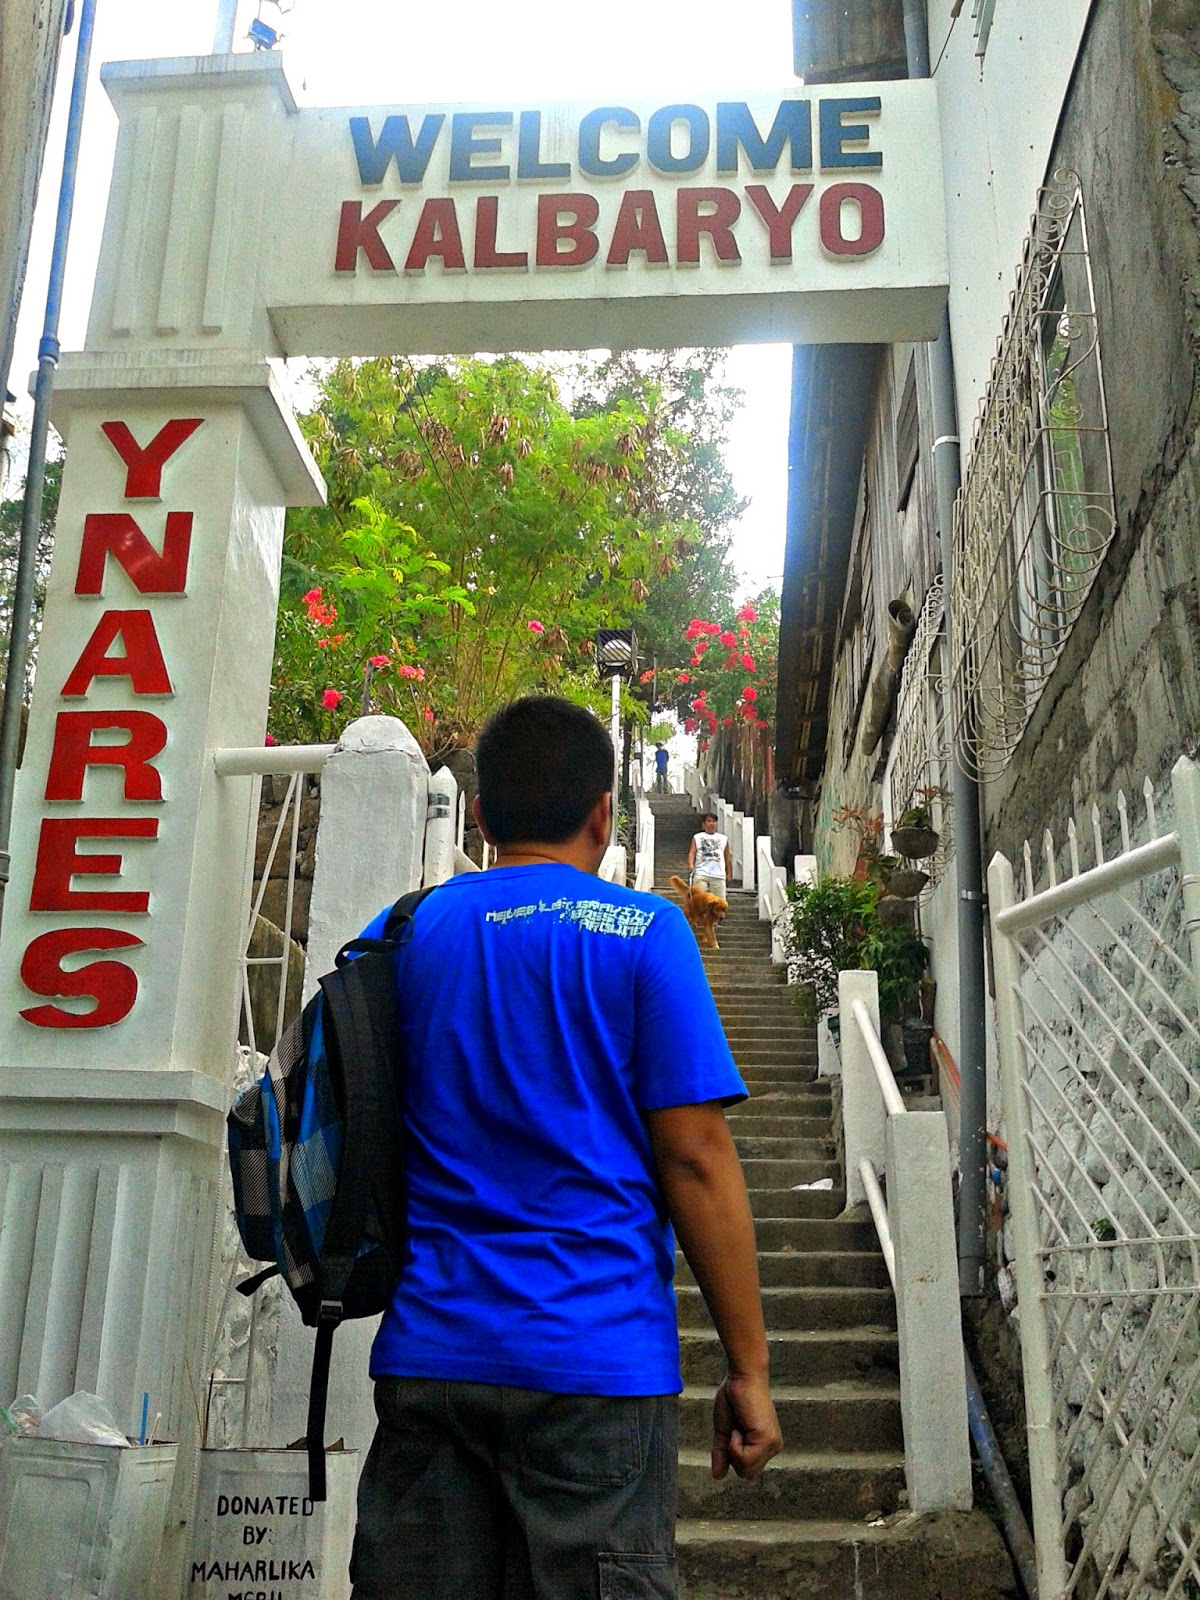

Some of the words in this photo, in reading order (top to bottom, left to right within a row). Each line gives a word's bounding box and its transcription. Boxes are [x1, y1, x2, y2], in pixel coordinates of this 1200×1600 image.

[349, 96, 883, 185] WELCOME
[334, 182, 886, 275] KALBARYO
[19, 418, 205, 1029] YNARES
[217, 1495, 314, 1516] DONATED
[191, 1560, 315, 1583] MAHARLIKA
